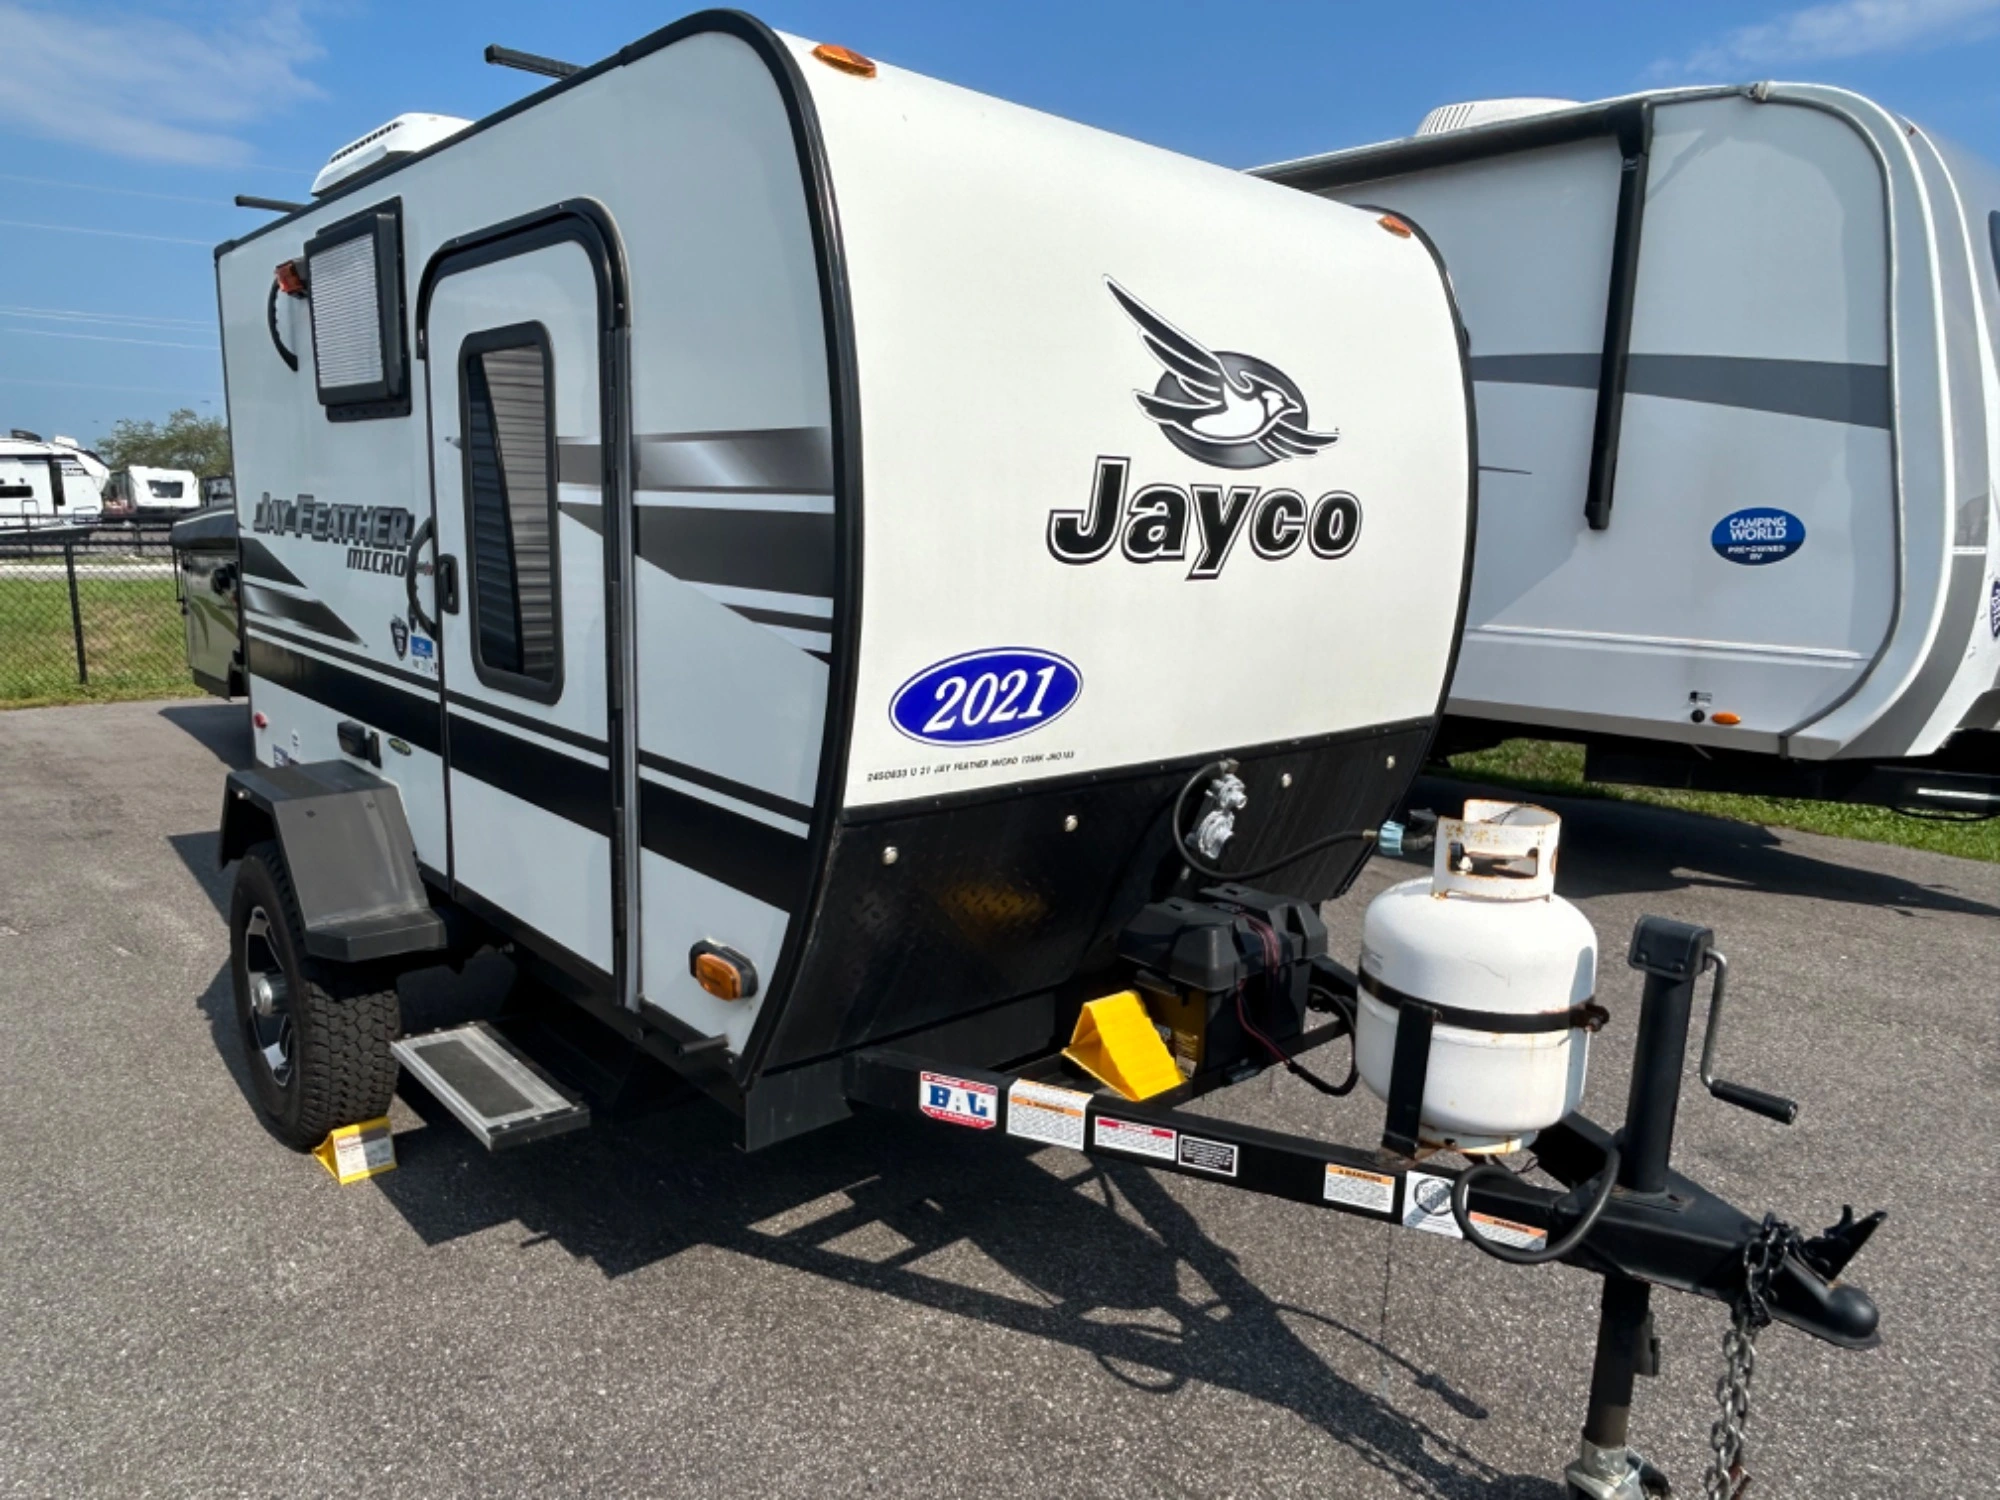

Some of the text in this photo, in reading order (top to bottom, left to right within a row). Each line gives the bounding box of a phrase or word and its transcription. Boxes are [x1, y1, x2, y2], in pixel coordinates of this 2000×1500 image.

[253, 492, 410, 552] JAY FEATHER
[1046, 455, 1363, 581] Jayco
[1729, 516, 1786, 528] CAMPING
[1729, 527, 1787, 541] WORLD
[346, 547, 408, 578] MICRO
[921, 665, 1057, 734] 2021
